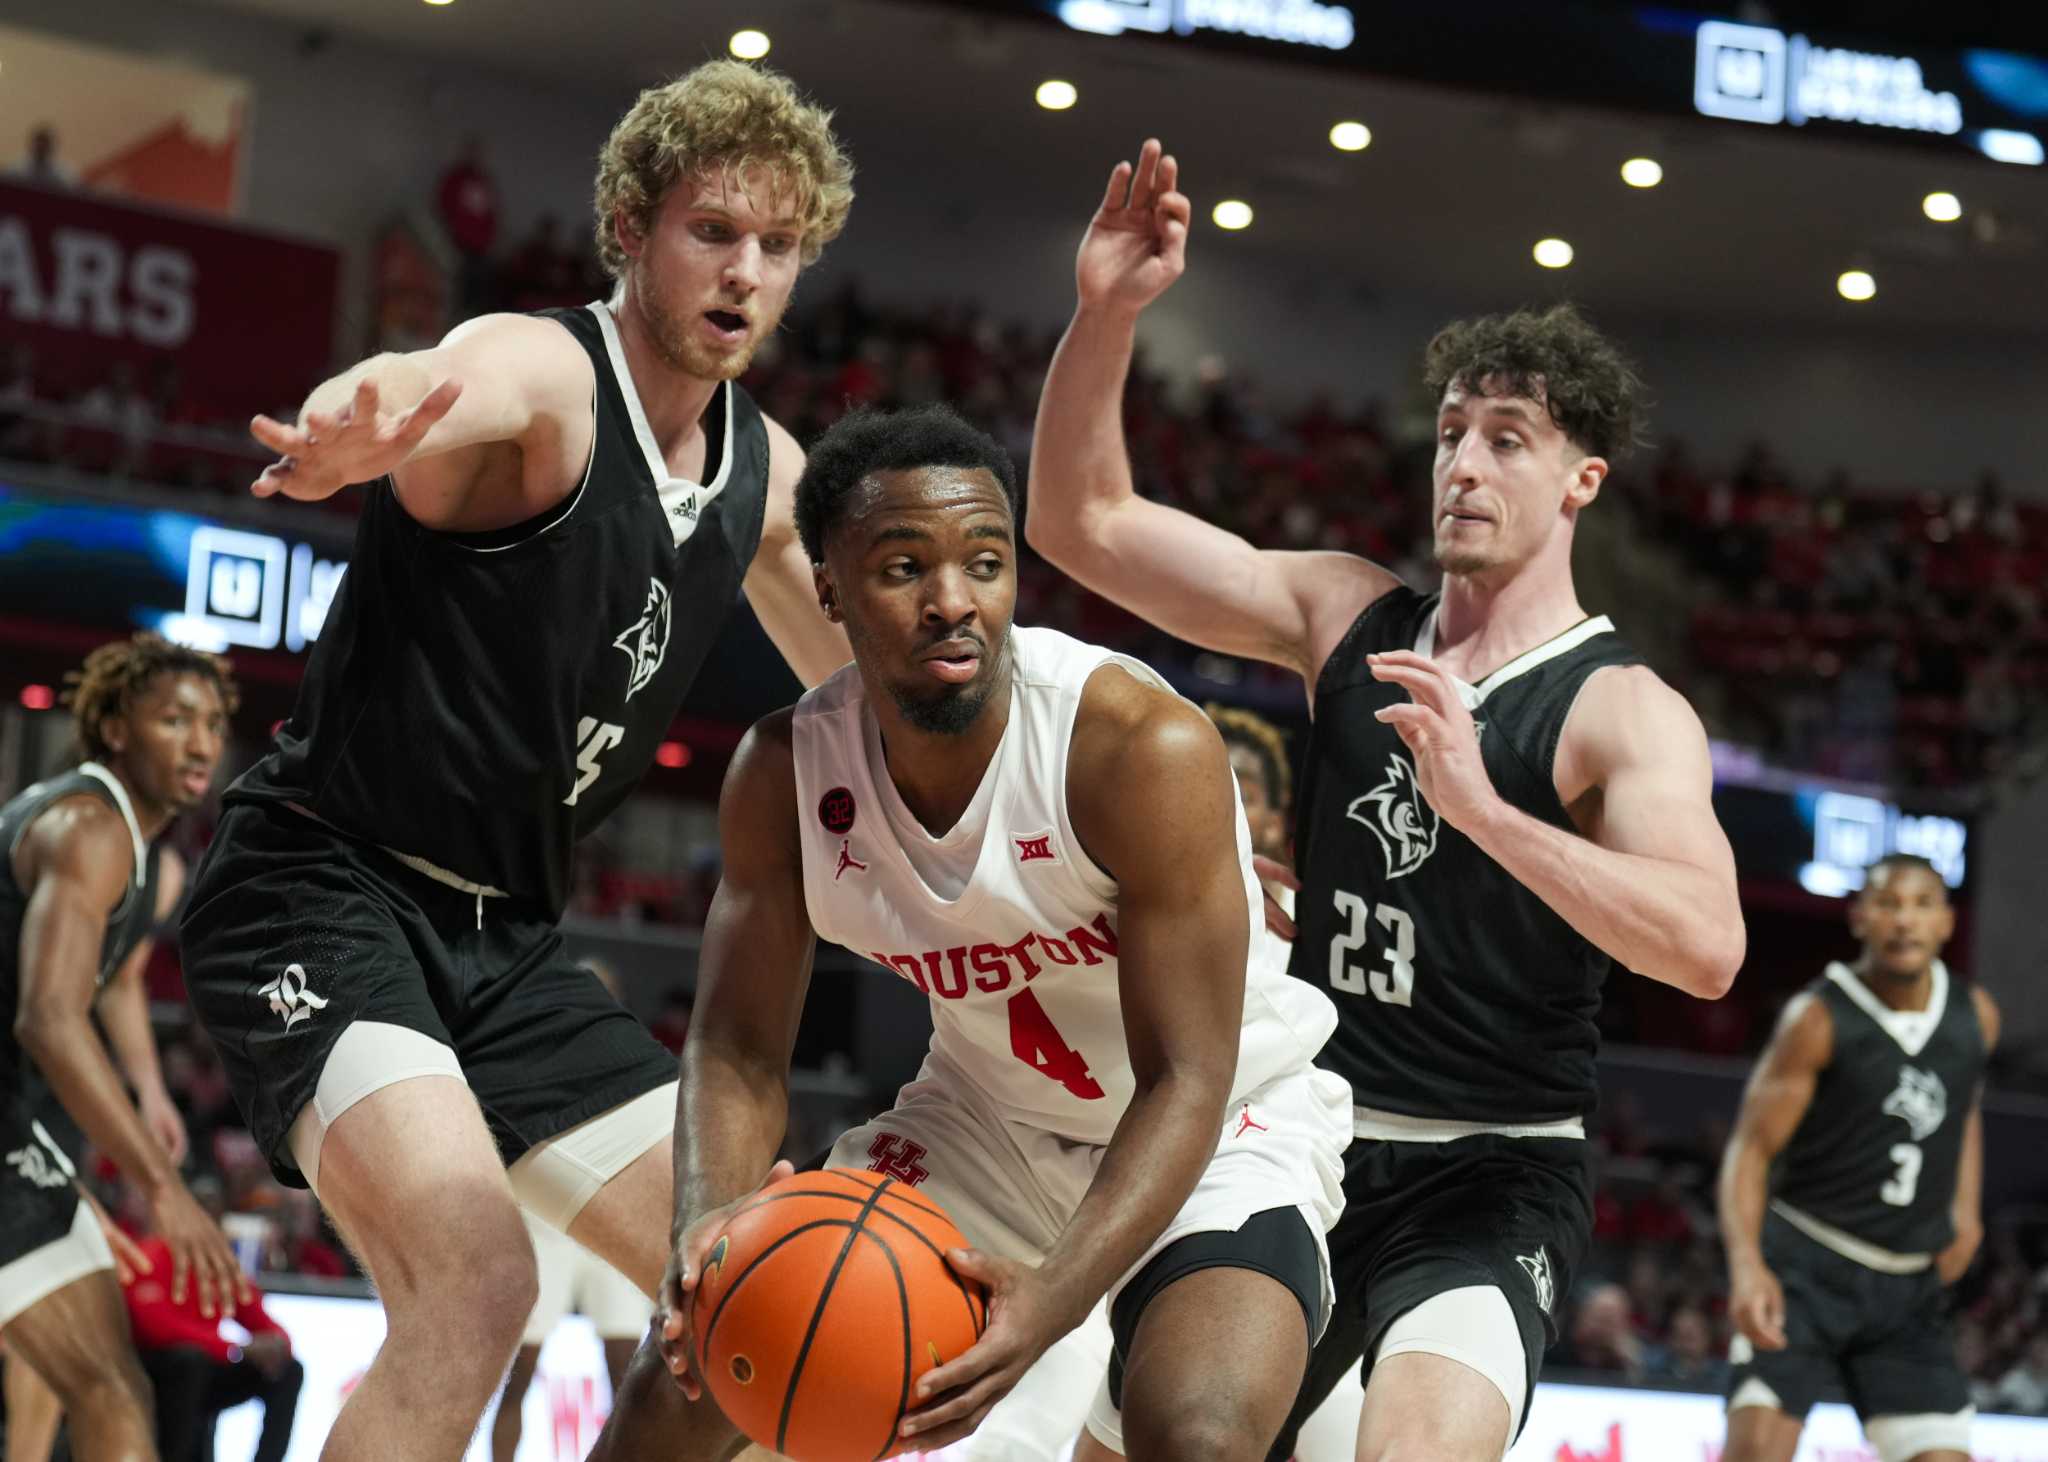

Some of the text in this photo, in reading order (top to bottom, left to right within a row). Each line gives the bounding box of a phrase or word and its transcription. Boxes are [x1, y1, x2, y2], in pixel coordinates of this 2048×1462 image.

[870, 912, 1119, 1000] OUSTON
[1328, 888, 1417, 1008] 23
[1007, 985, 1106, 1101] 4
[1881, 1144, 1923, 1207] 3
